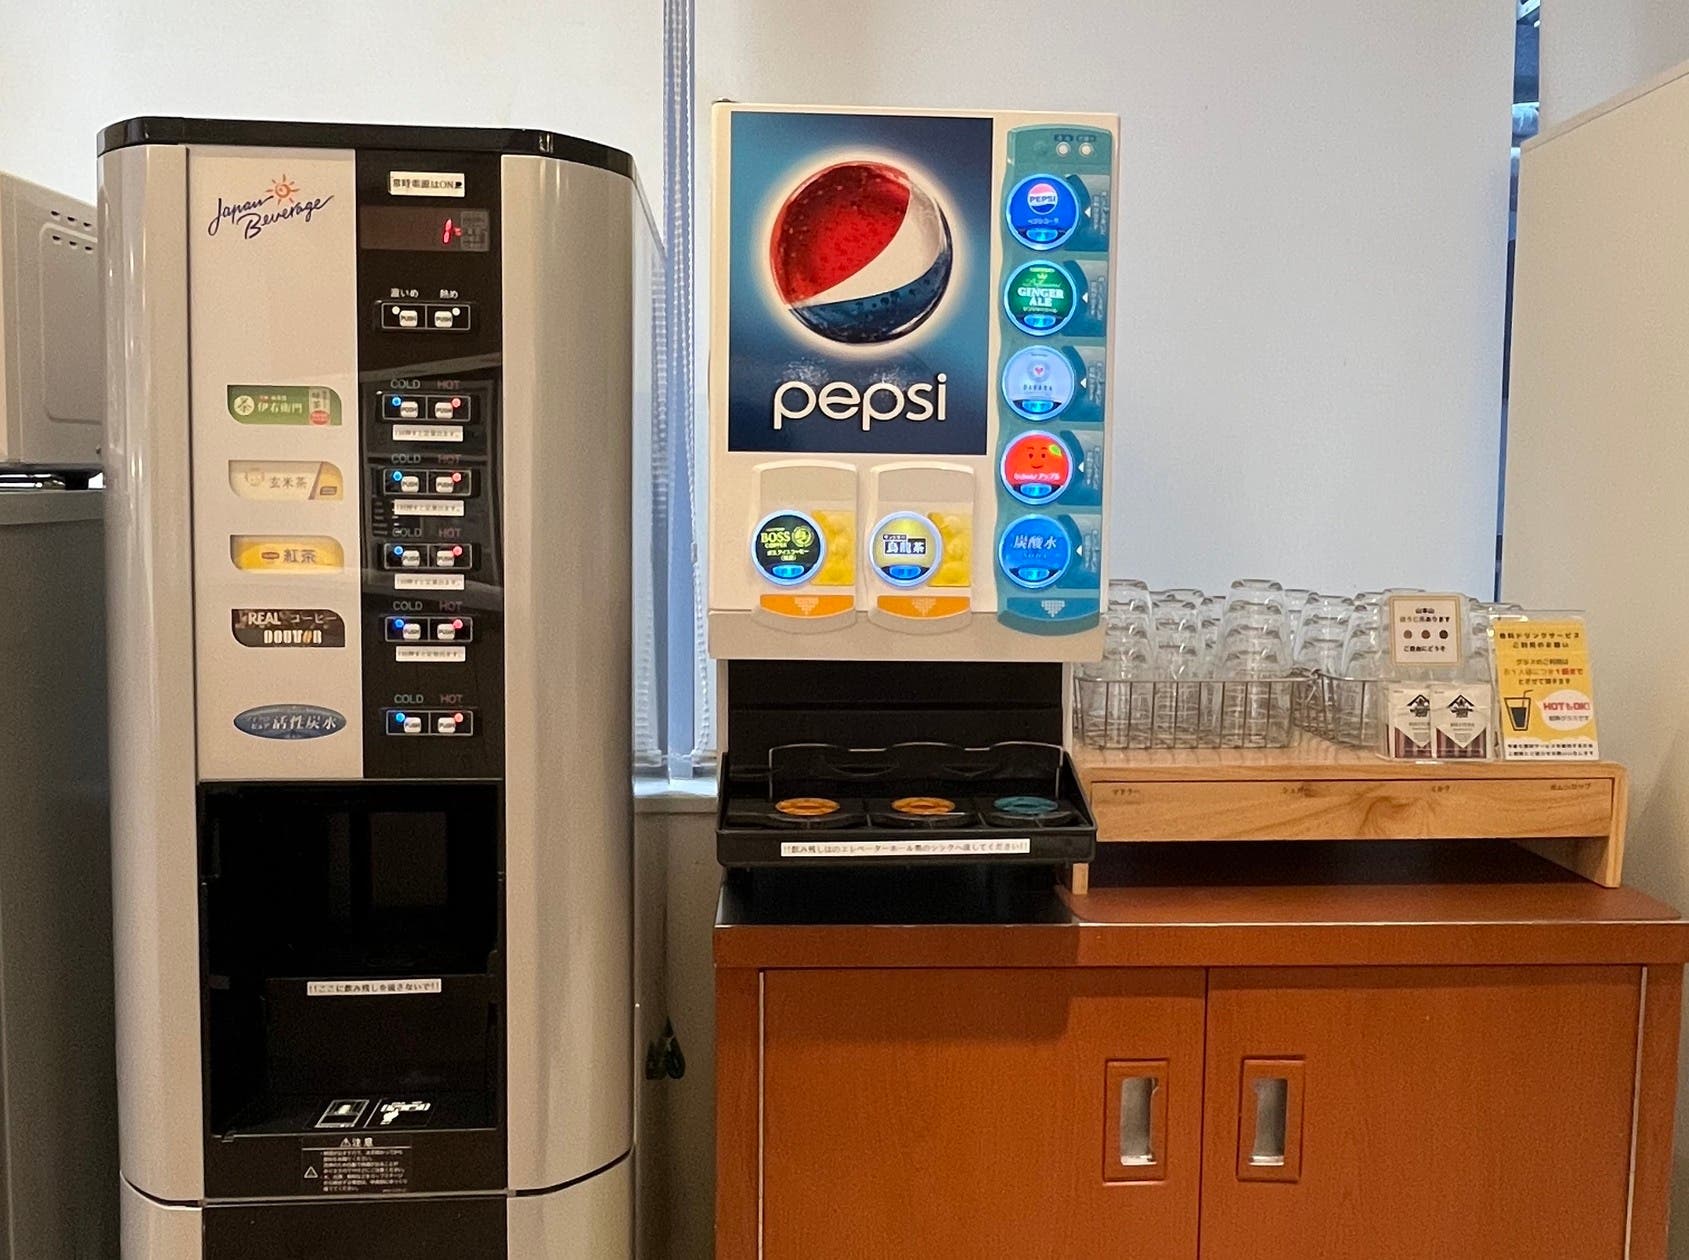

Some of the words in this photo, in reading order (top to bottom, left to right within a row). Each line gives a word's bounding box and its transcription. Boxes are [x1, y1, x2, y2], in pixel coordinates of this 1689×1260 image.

[207, 197, 274, 236] Japan
[236, 195, 335, 239] Beverage
[1017, 287, 1064, 299] GINGER
[1029, 296, 1053, 307] ALE
[390, 379, 421, 389] COLD
[437, 380, 461, 389] HOT
[773, 373, 947, 431] pepsi
[392, 454, 421, 464] COLD
[438, 454, 462, 464] HOT
[269, 476, 307, 488] 玄米茶
[392, 528, 422, 537] COLD
[439, 528, 461, 537] HOT
[761, 531, 790, 543] BOSS
[1013, 535, 1057, 550] 炭酸水
[283, 549, 316, 564] 紅茶
[393, 601, 423, 611] COLD
[440, 601, 463, 611] HOT
[248, 612, 281, 625] REAL
[290, 613, 337, 624] コーヒー
[394, 694, 424, 704] COLD
[440, 694, 463, 704] HOT
